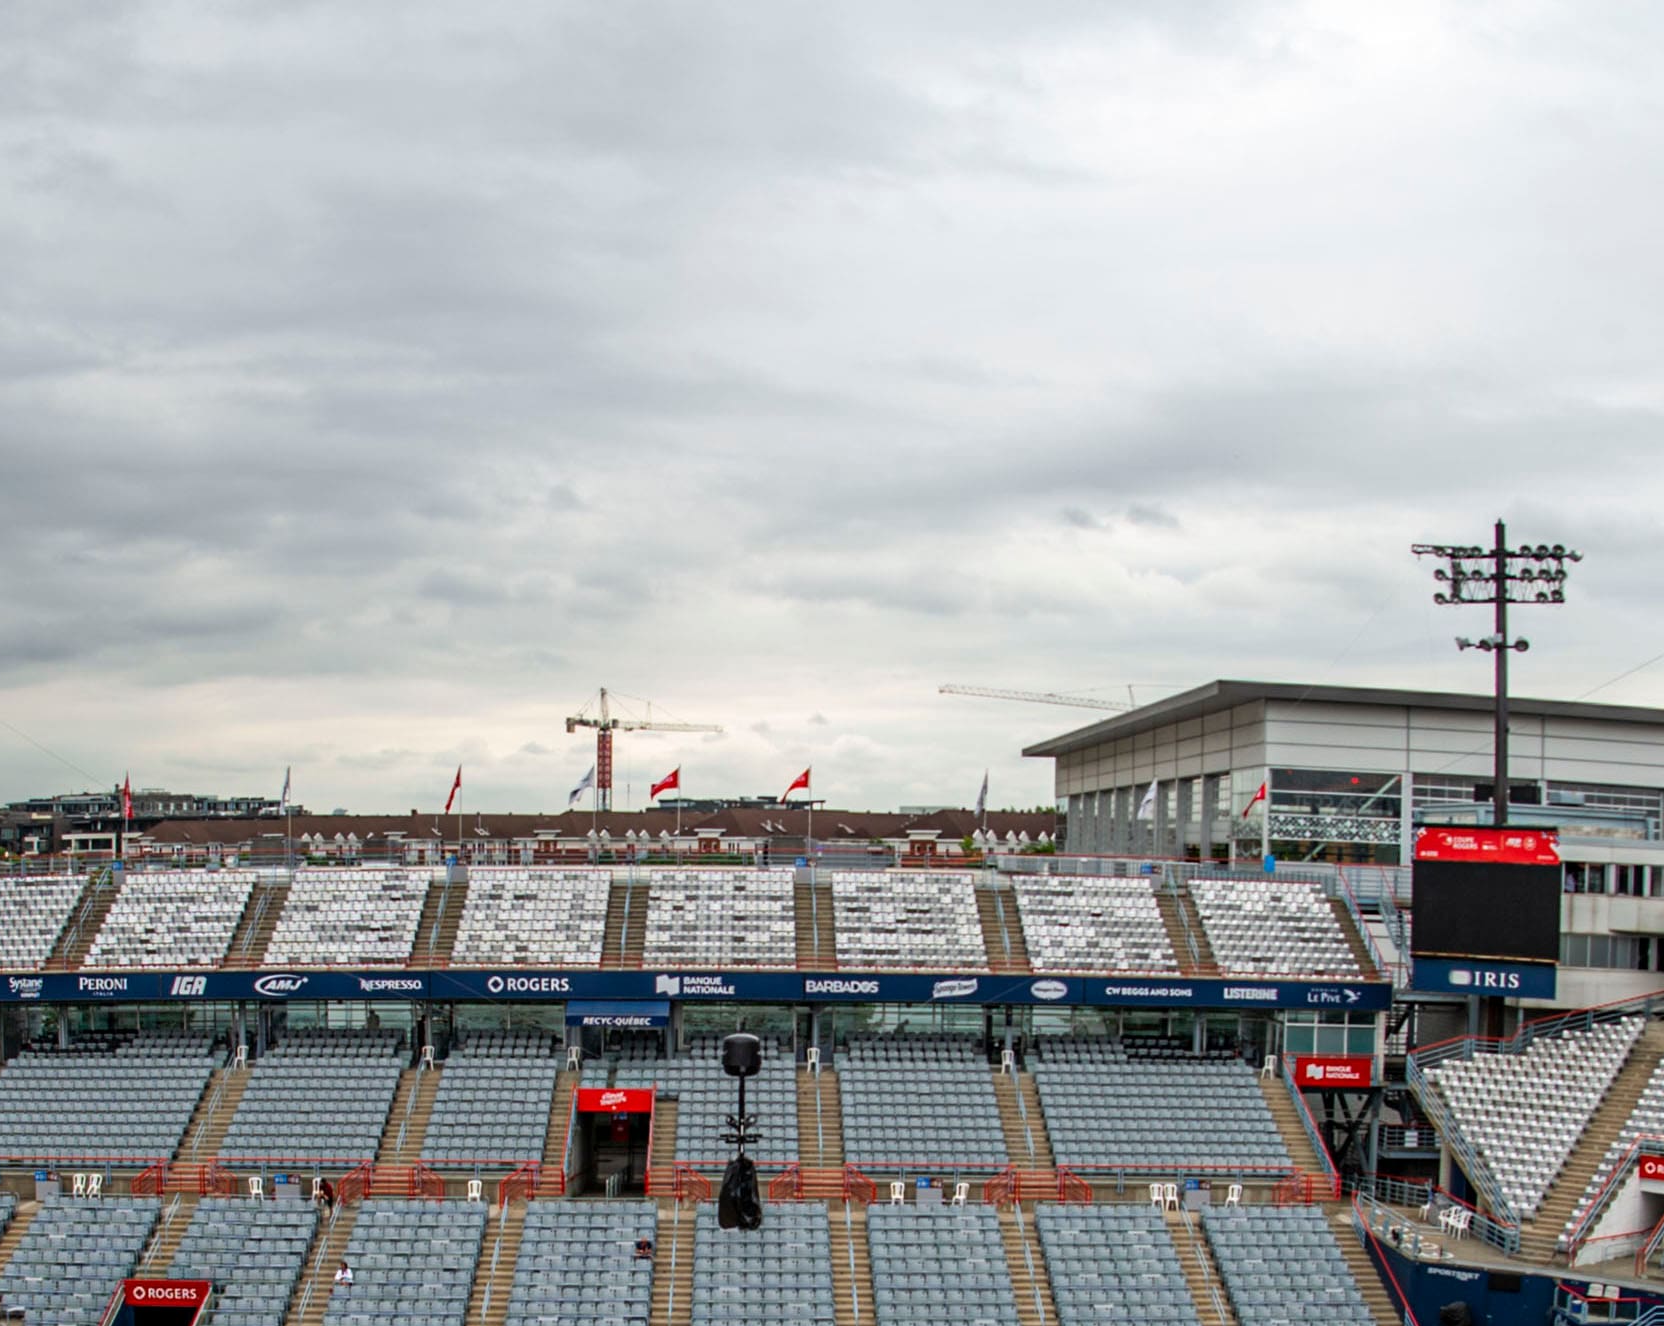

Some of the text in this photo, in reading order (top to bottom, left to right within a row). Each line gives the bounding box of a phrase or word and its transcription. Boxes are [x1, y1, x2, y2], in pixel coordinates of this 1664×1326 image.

[9, 977, 43, 992] Systane
[79, 977, 127, 991] PERONI
[171, 976, 207, 995] IGA
[264, 979, 303, 991] AMJ
[358, 978, 422, 992] NESPRESSO
[507, 978, 569, 991] ROGERS
[683, 977, 722, 986] BANQUE
[1474, 971, 1520, 988] IRIS
[683, 985, 735, 994] NATIONALE
[805, 980, 880, 994] BARBADOS
[1106, 987, 1192, 997] CW BEGGS AND SONS
[1224, 988, 1277, 1000] LISTERINE
[583, 1015, 652, 1026] RECYC-QUÉBEC
[148, 1288, 197, 1299] ROGERS
